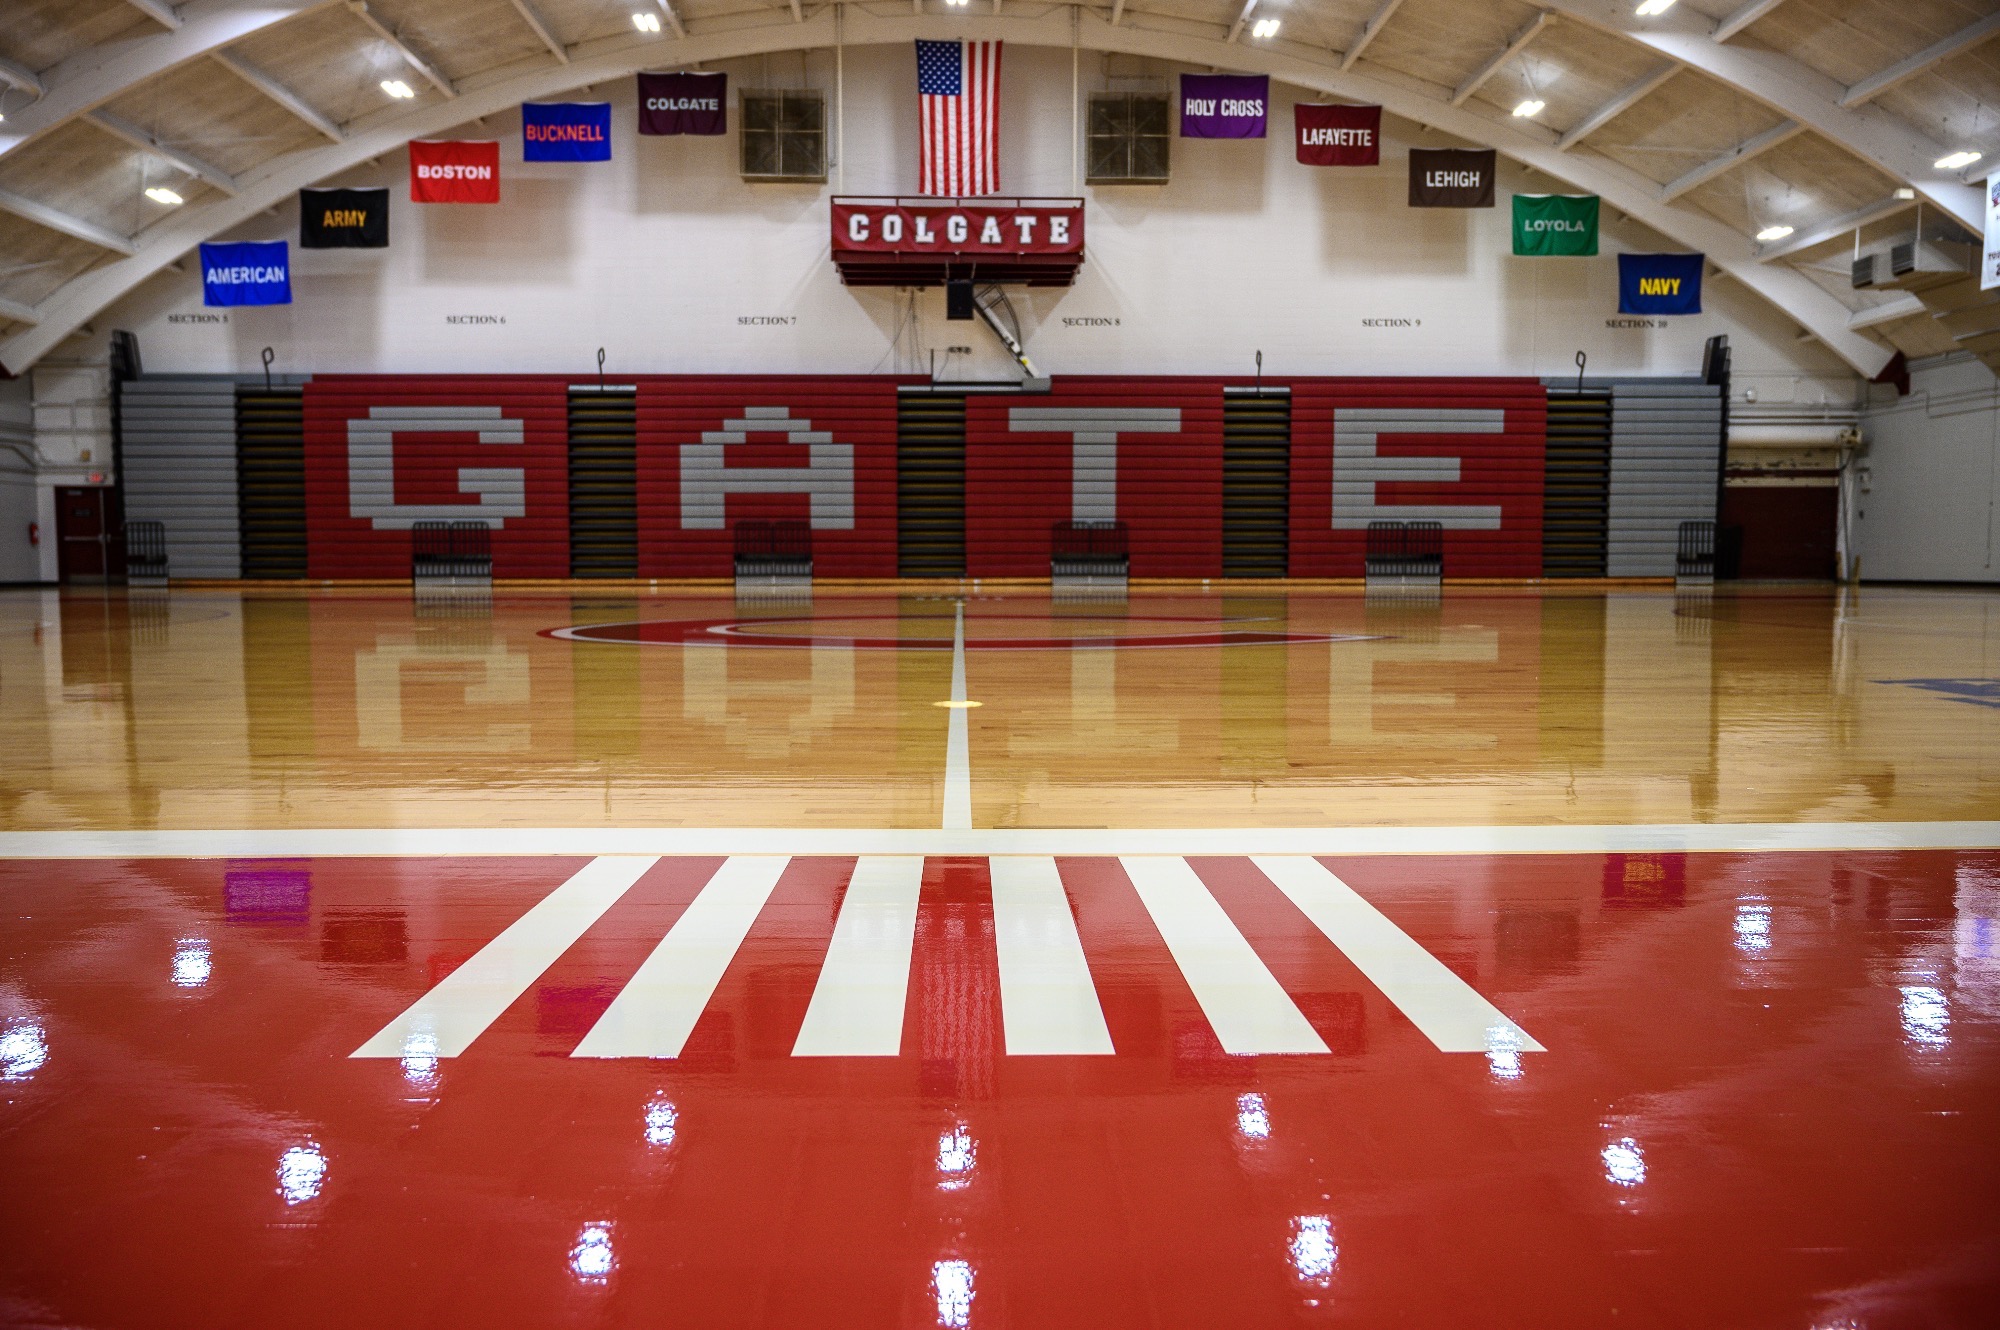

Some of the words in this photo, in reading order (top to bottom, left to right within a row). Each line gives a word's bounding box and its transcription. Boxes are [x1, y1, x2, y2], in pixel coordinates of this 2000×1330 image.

[646, 97, 719, 111] COLGATE
[1185, 98, 1216, 118] HOLY
[1220, 98, 1264, 118] CROSS
[525, 124, 604, 143] BUCKNELL
[1302, 127, 1372, 147] LAFAYETTE
[417, 164, 491, 180] BOSTON
[1425, 170, 1480, 188] LEHIGH
[322, 210, 366, 229] ARMY
[1524, 219, 1585, 233] LOYOLA
[848, 213, 1070, 244] COLGATE
[206, 266, 285, 285] AMERICAN
[1640, 277, 1681, 296] NAVY
[168, 313, 219, 324] SECTION
[446, 315, 498, 325] SECTION
[737, 316, 789, 326] SECTION
[1061, 317, 1112, 328] SECTION
[1361, 318, 1411, 328] SECTION
[1605, 319, 1655, 329] SECTION
[347, 406, 1506, 530] GATE
